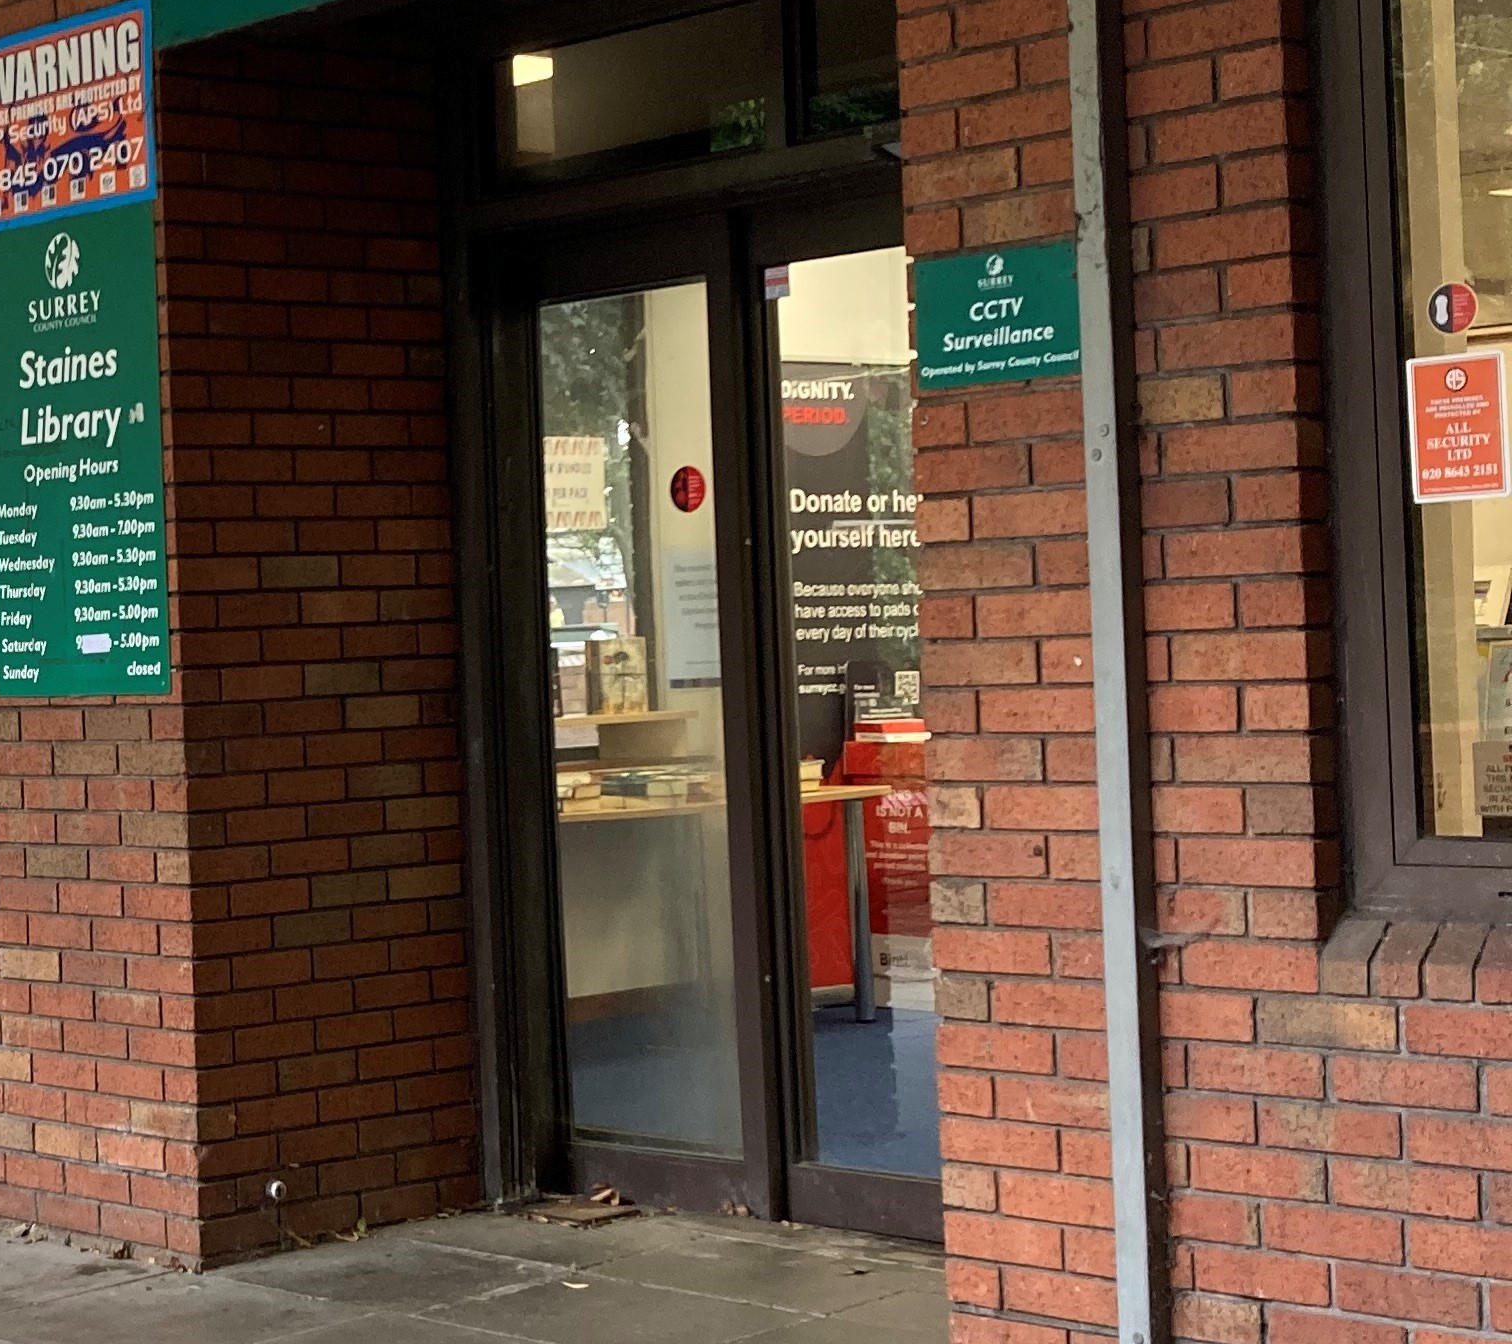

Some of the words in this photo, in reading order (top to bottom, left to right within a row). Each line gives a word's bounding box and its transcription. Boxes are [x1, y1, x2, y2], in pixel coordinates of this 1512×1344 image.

[10, 96, 55, 123] PREMISES
[56, 93, 75, 111] ARE
[75, 77, 127, 106] PROTECTED
[128, 74, 142, 91] BY
[8, 114, 67, 143] Security
[71, 100, 114, 131] (APS)
[119, 92, 143, 115] Ltd
[43, 151, 84, 182] 070
[89, 137, 144, 171] 2407
[977, 274, 1014, 289] SURREY
[28, 289, 101, 323] SURREY
[969, 296, 1024, 322] CCTV
[33, 319, 63, 333] COUNTY
[64, 313, 97, 329] COUNCIL
[943, 325, 1055, 352] Surveillance
[19, 346, 118, 389] Staines
[921, 362, 963, 378] Operated
[964, 361, 976, 375] by
[977, 359, 1006, 371] Surrey
[1008, 356, 1042, 367] County
[1043, 349, 1080, 363] Council
[21, 405, 122, 448] Library
[1445, 421, 1471, 435] ALL
[1426, 433, 1491, 451] SECURITY
[1447, 448, 1473, 461] LTD
[24, 462, 77, 487] Opening
[79, 458, 119, 477] Hours
[1422, 467, 1442, 480] 020
[70, 496, 107, 512] 9.30am
[114, 490, 155, 509] 5.30pm
[790, 488, 862, 513] Donate
[867, 494, 888, 513] or
[72, 523, 109, 539] 9.30am
[117, 519, 156, 538] 7.00pm
[790, 524, 875, 554] yourself
[72, 551, 109, 567] 9.30am
[116, 547, 157, 566] 5.30pm
[0, 583, 46, 601] Thursday
[74, 579, 111, 595] 9.30am
[118, 576, 158, 595] 5.30pm
[793, 581, 846, 597] Because
[847, 583, 900, 599] everyone
[1, 611, 32, 629] Friday
[74, 607, 111, 623] 9.30am
[119, 604, 159, 623] 5.00pm
[794, 603, 826, 619] have
[827, 605, 867, 618] access
[869, 603, 881, 617] to
[883, 601, 910, 619] pads
[1, 638, 47, 656] Saturday
[120, 632, 160, 652] 5.00pm
[796, 627, 831, 643] every
[832, 624, 853, 643] day
[854, 623, 867, 639] of
[868, 623, 894, 638] their
[3, 665, 39, 683] Sunday
[127, 661, 161, 677] closed
